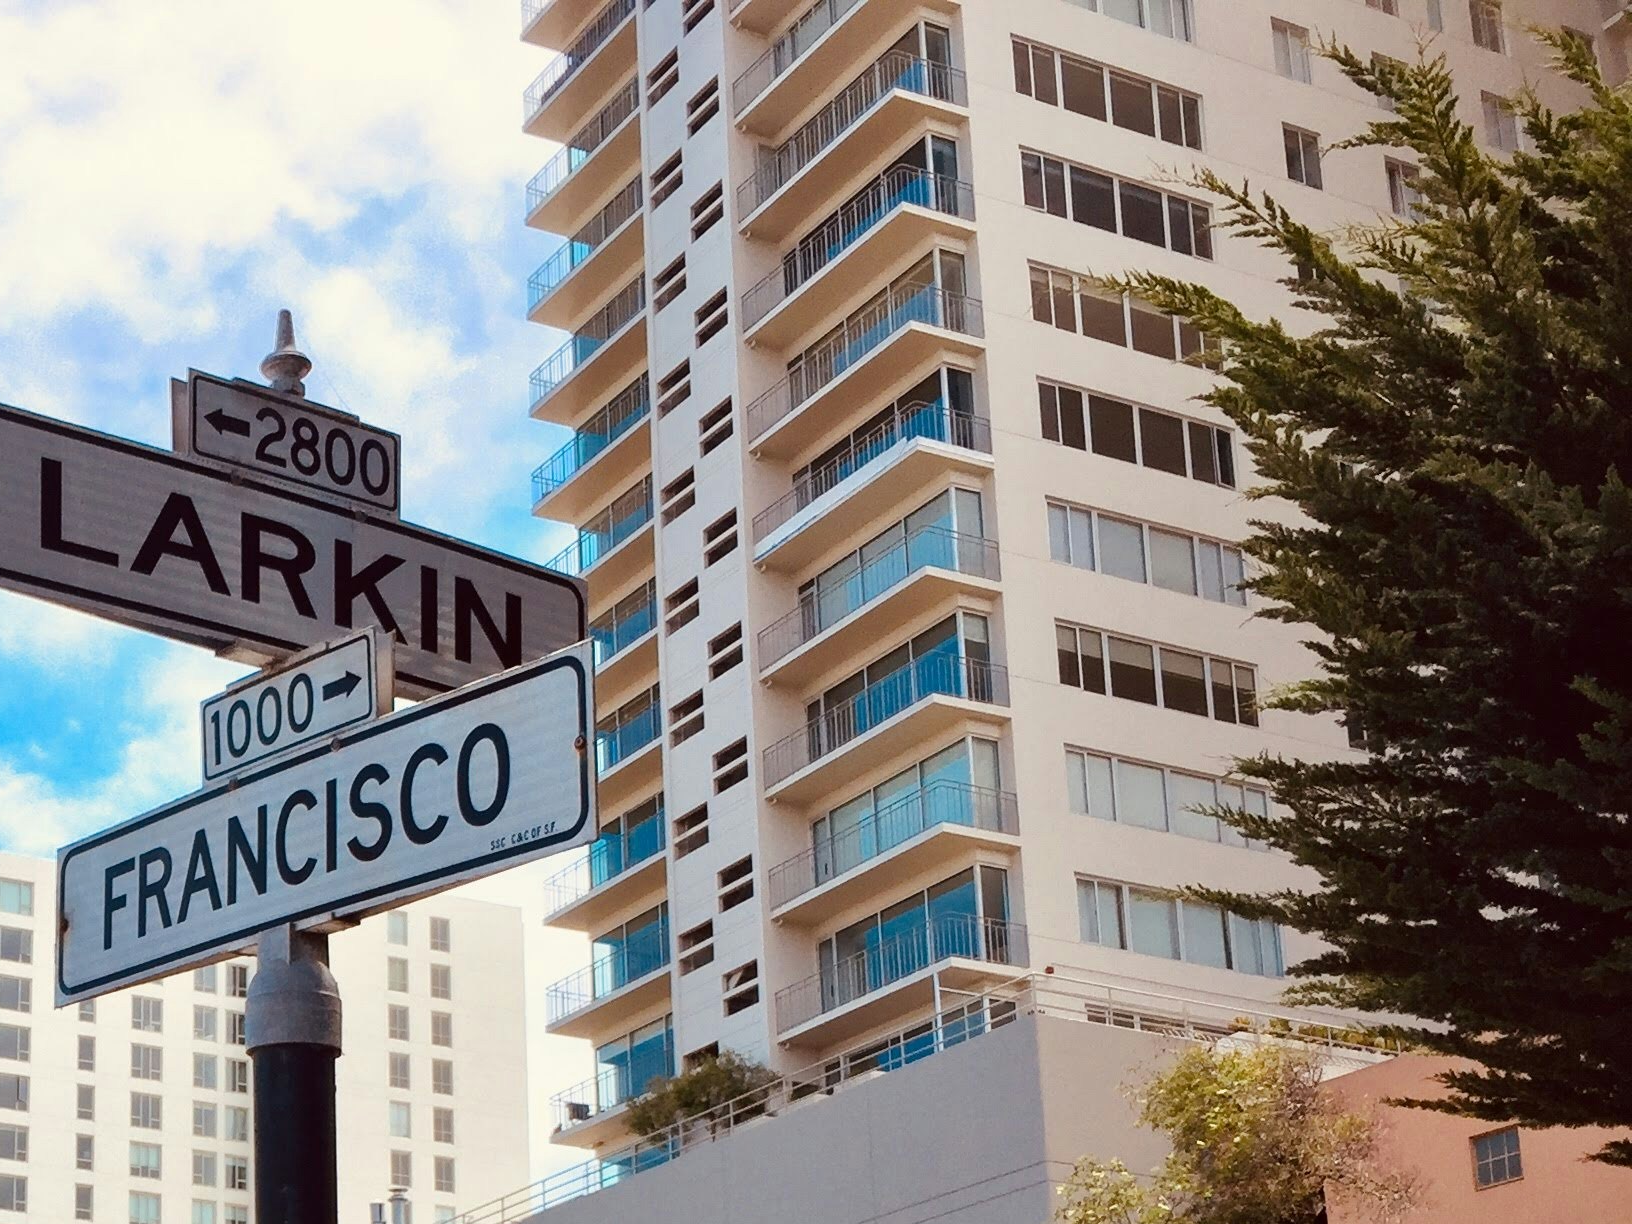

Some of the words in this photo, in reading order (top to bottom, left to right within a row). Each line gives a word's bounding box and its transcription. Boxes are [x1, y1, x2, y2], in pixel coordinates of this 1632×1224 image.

[255, 407, 390, 496] 2800
[41, 457, 522, 670] LARKIN
[210, 672, 314, 766] 1000
[103, 723, 510, 950] FRANCISCO
[531, 826, 542, 839] OF
